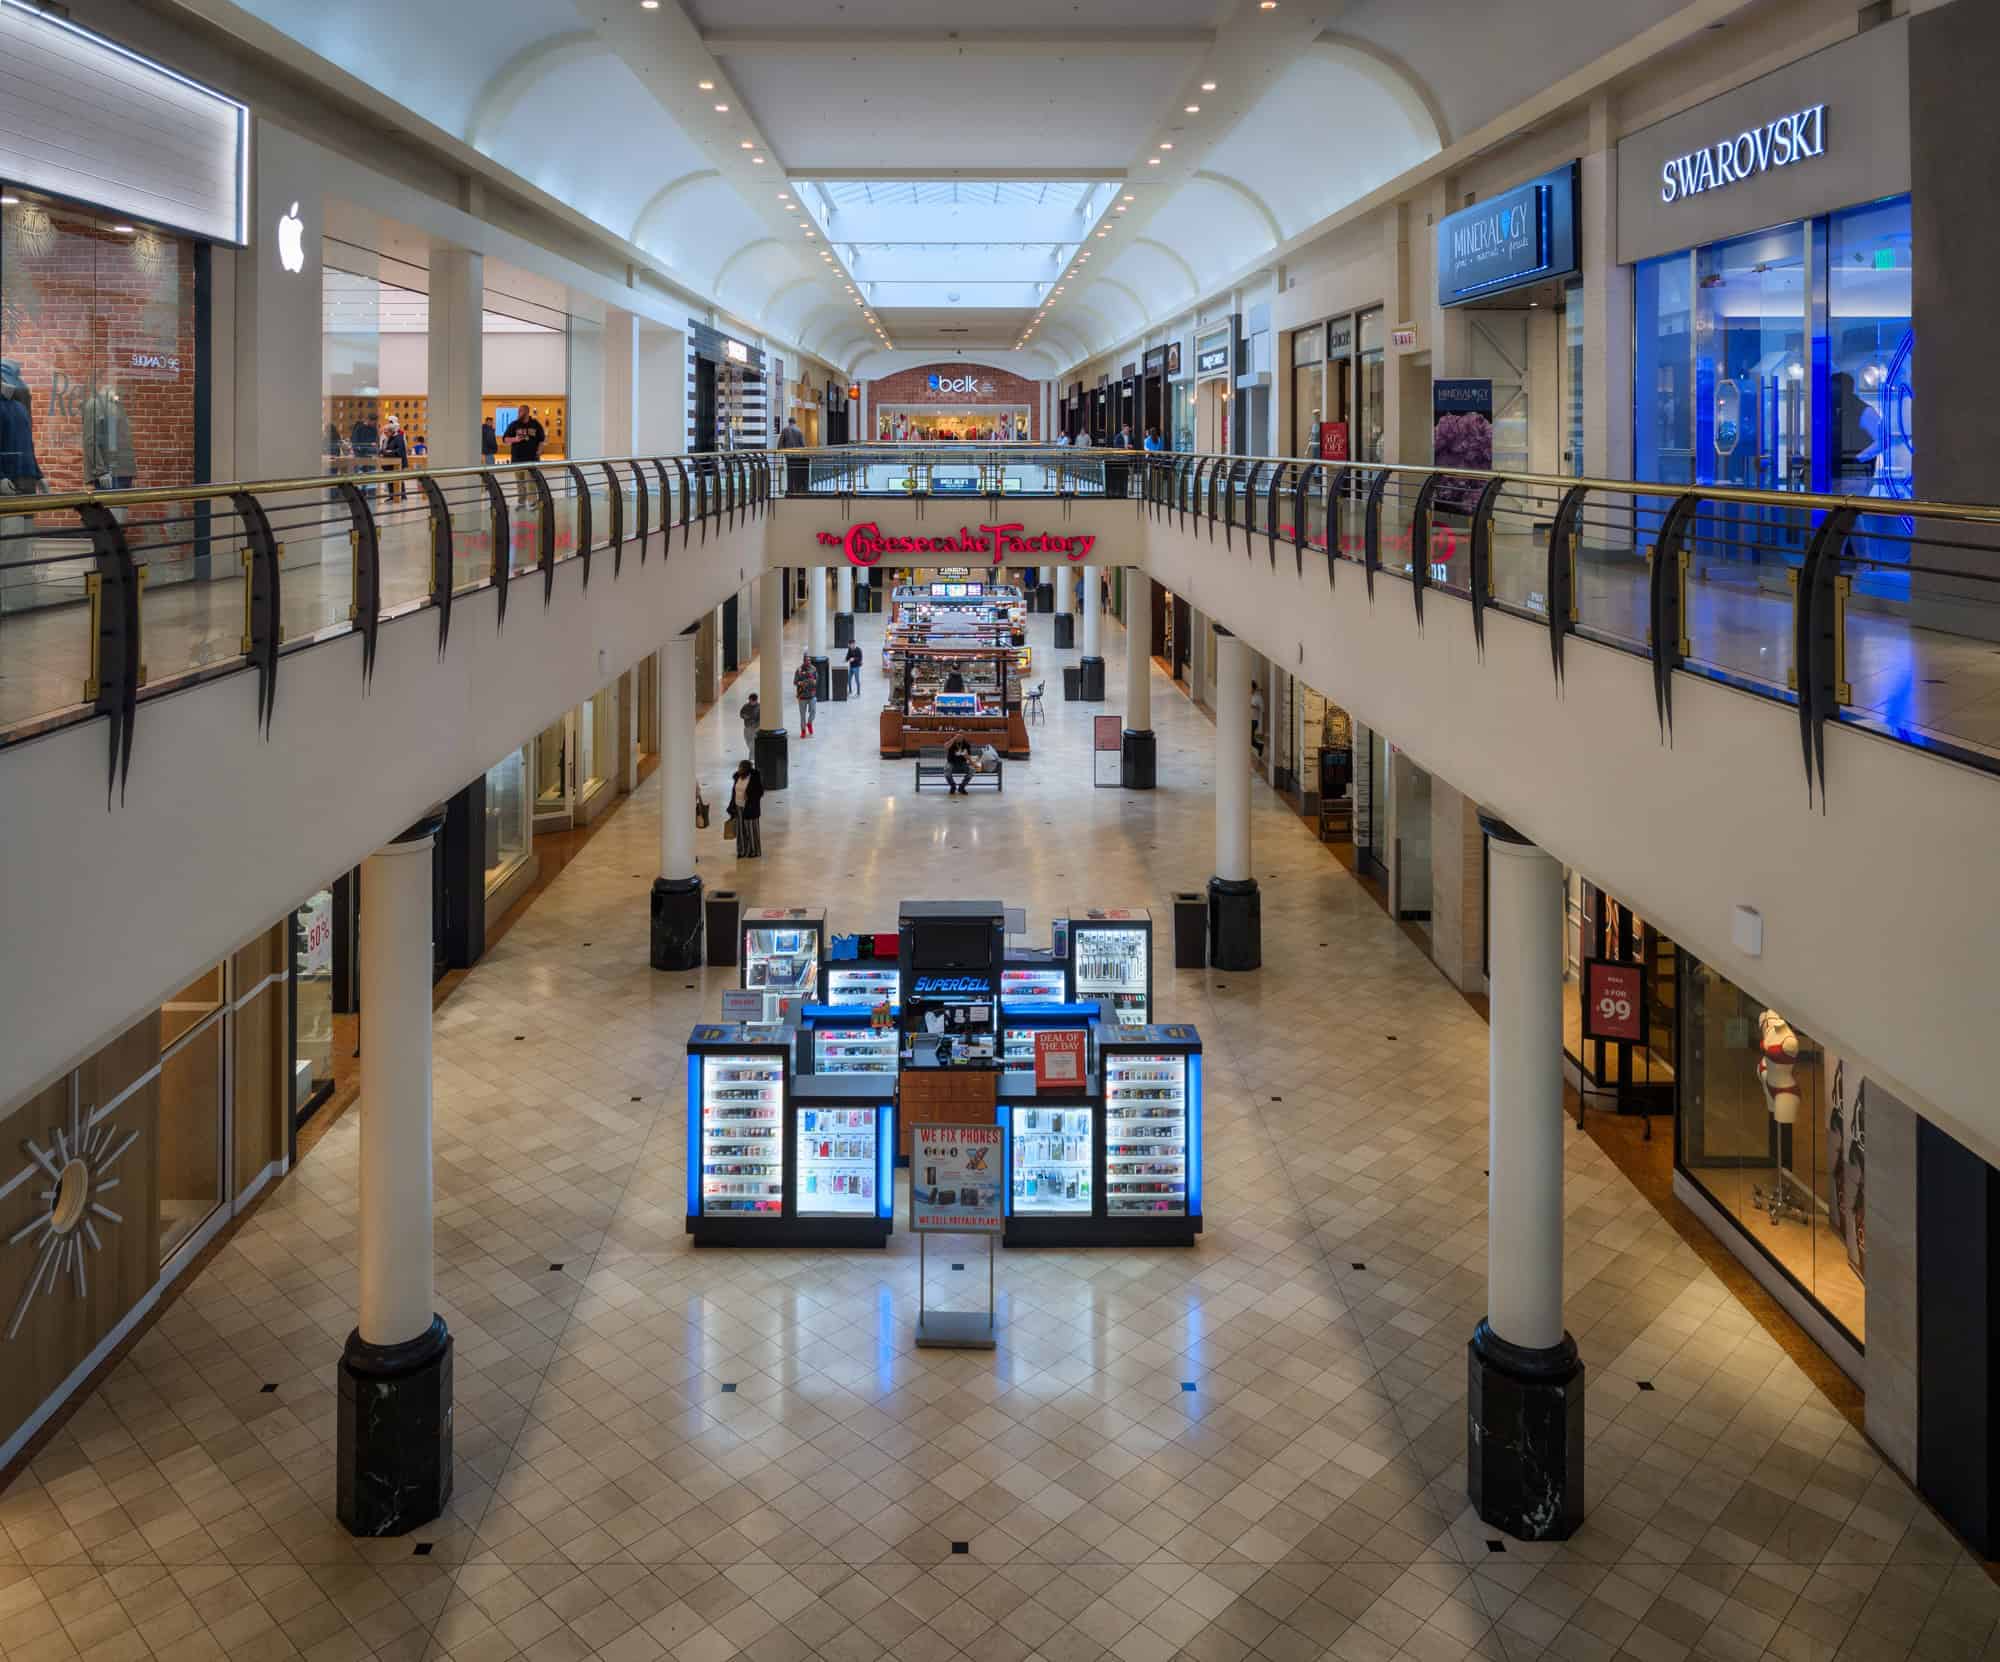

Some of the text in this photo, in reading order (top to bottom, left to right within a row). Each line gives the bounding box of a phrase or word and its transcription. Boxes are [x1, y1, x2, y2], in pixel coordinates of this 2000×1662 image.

[1661, 104, 1826, 203] SWAROVSKI
[938, 376, 979, 393] belk
[844, 522, 990, 567] Cheesecake
[979, 523, 1097, 565] Factory
[1040, 1032, 1079, 1042] DEAL OF
[1040, 1042, 1080, 1051] THE DAY
[920, 1128, 937, 1143] WE
[940, 1128, 957, 1143] FIX
